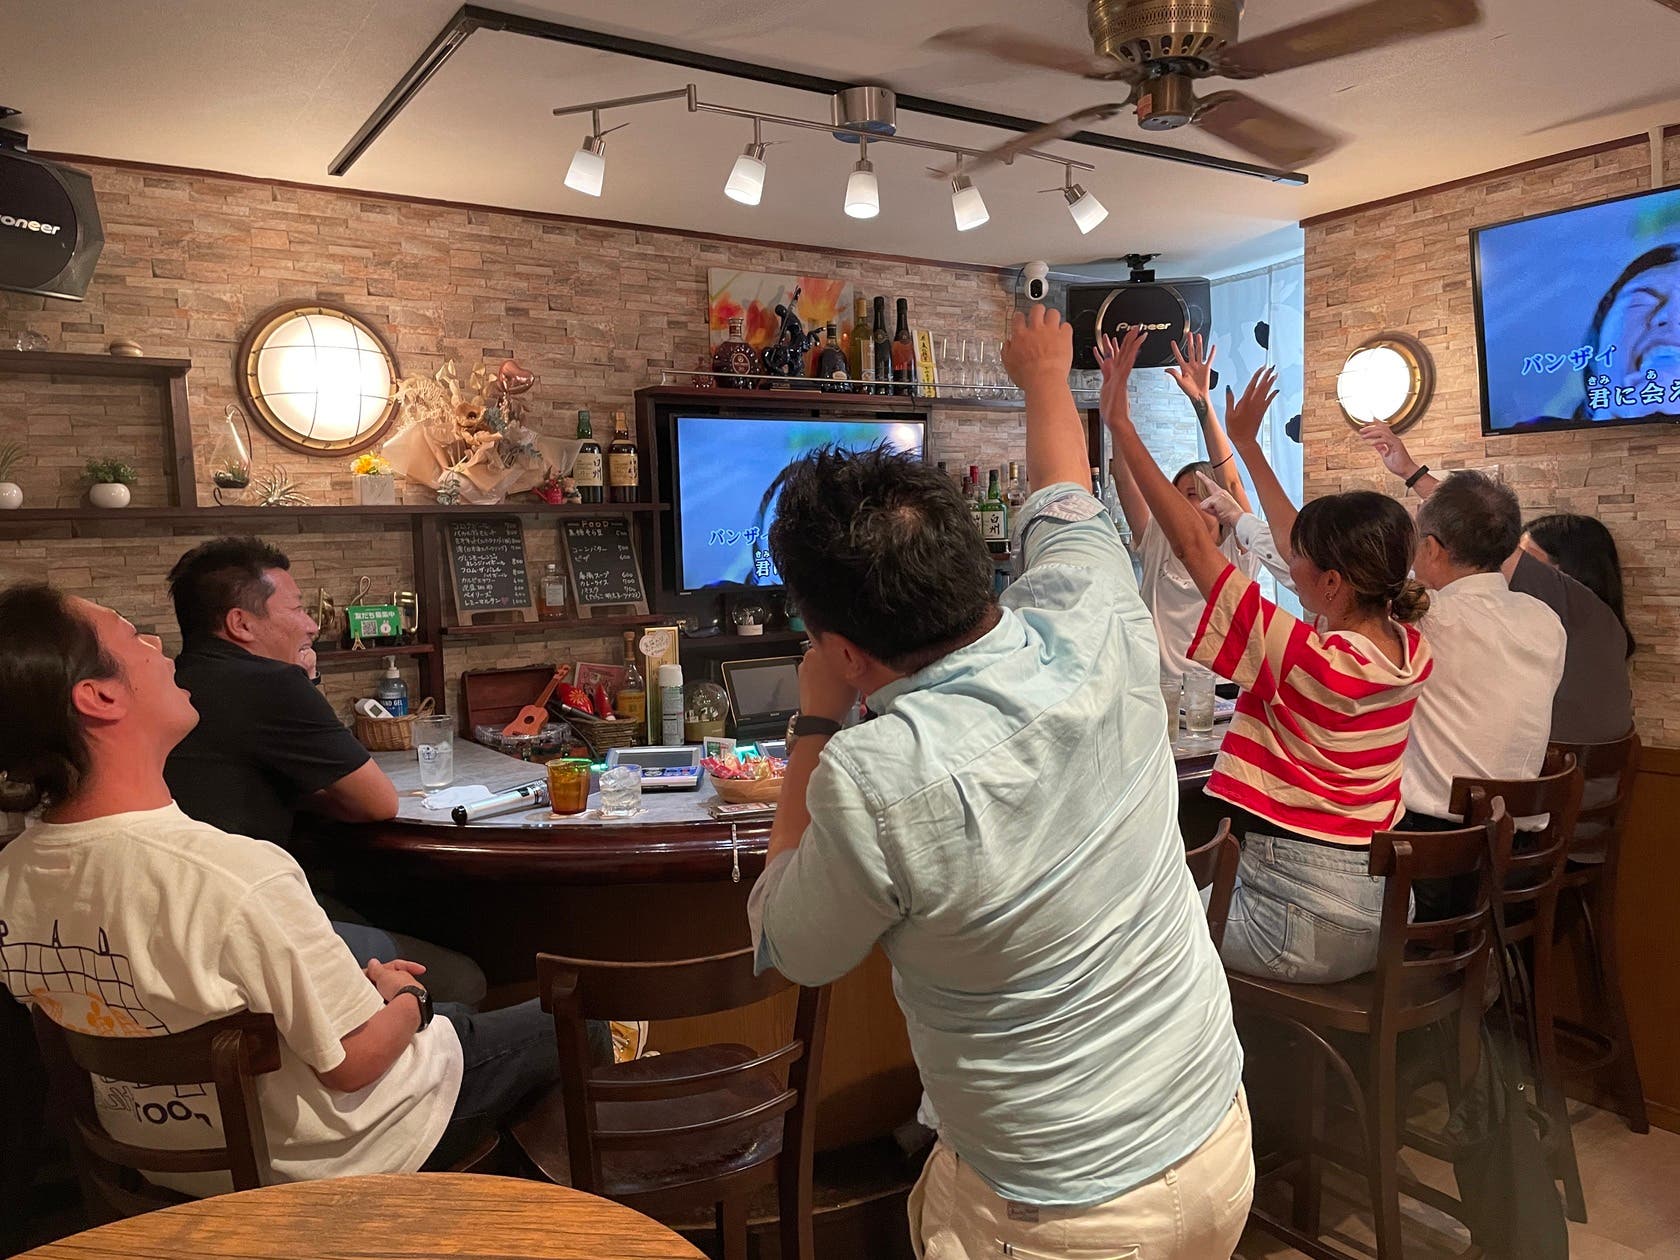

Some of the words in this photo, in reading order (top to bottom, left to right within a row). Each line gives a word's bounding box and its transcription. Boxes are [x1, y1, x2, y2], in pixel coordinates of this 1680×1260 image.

[0, 214, 61, 235] oneer
[1116, 323, 1171, 331] Pineer
[581, 520, 609, 528] FOOD
[989, 513, 1000, 535] 白州
[355, 611, 395, 620] 友だち募集中
